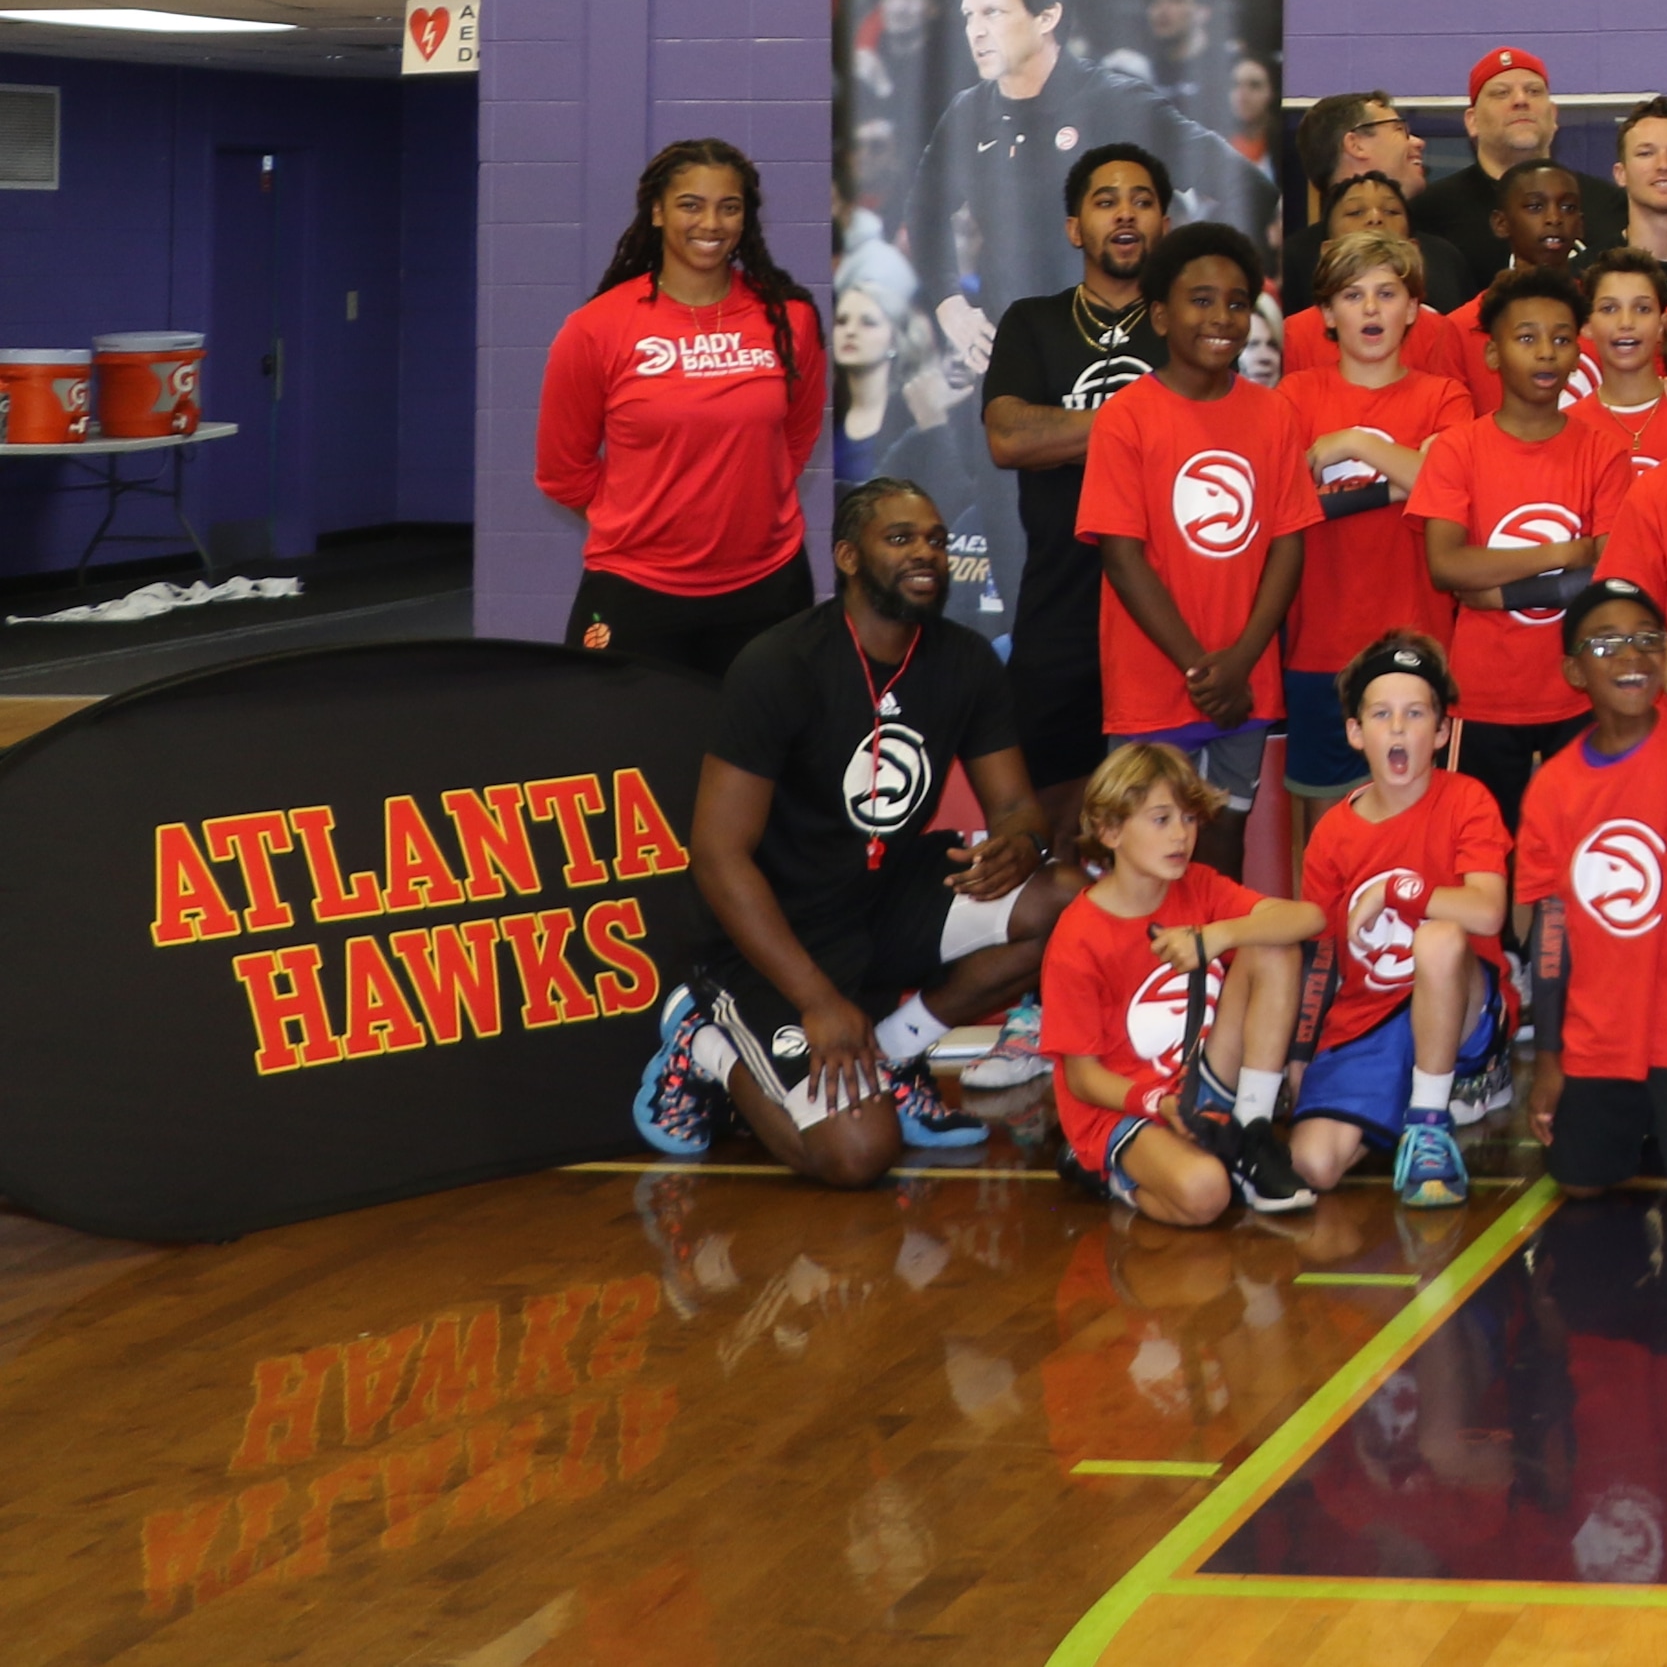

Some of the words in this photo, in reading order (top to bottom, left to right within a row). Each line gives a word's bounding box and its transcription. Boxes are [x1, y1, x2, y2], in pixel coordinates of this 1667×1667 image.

[679, 332, 741, 355] LADY
[682, 348, 775, 371] BALLERS
[151, 767, 689, 946] ATLANTA
[233, 898, 660, 1075] HAWKS
